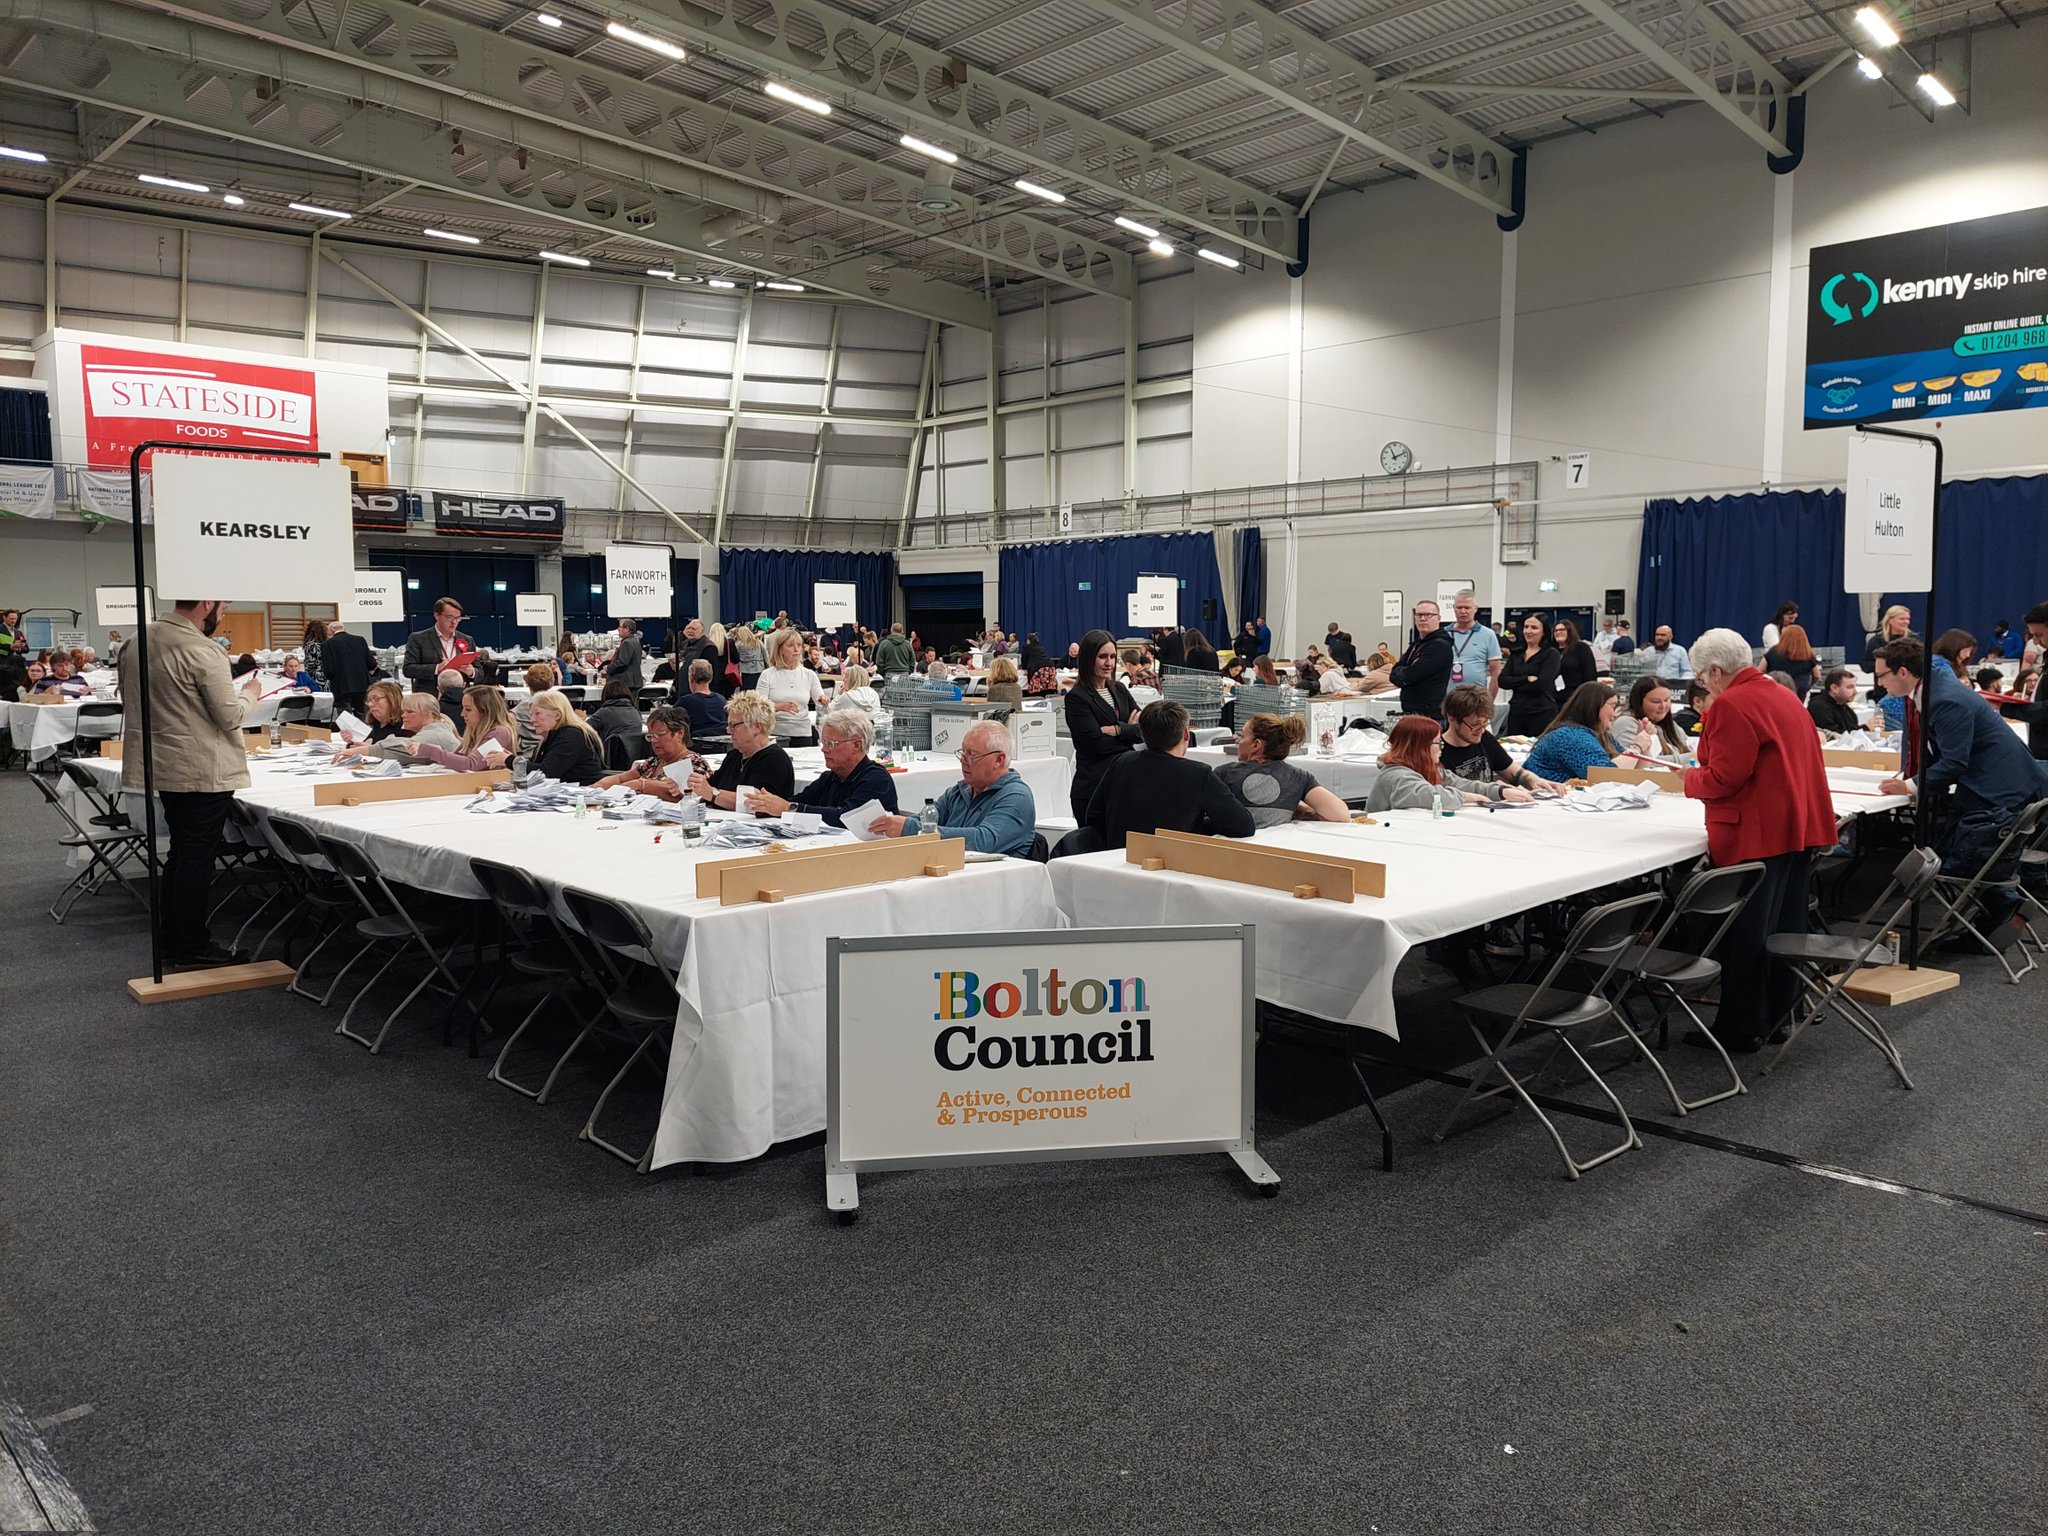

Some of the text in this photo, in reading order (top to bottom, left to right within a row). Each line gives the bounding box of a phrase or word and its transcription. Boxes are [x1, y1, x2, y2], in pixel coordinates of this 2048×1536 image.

[1883, 266, 2047, 304] kenny skip hire
[1964, 321, 1993, 335] INSTANT
[1993, 318, 2019, 331] ONLINE
[1981, 329, 2046, 352] 01204 968
[111, 381, 299, 424] STATESIDE
[1892, 397, 1916, 409] MINI
[1927, 393, 1952, 406] MIDI
[1963, 389, 1991, 402] MAXI
[176, 424, 228, 438] FOODS
[92, 441, 100, 450] A
[1572, 464, 1583, 483] 7
[352, 494, 399, 512] AD
[1879, 492, 1901, 510] Little
[441, 500, 556, 522] HEAD
[1063, 512, 1069, 527] 8
[200, 521, 311, 540] KEARSLEY
[1875, 520, 1904, 537] Hulton
[610, 569, 667, 581] FARNWORTH
[624, 585, 656, 596] NORTH
[1671, 688, 1687, 696] LLOT
[933, 968, 1150, 1021] Bolton
[934, 1018, 1155, 1072] Council
[936, 1082, 1132, 1108] Active, Connected
[936, 1105, 1088, 1127] & Prosperous
